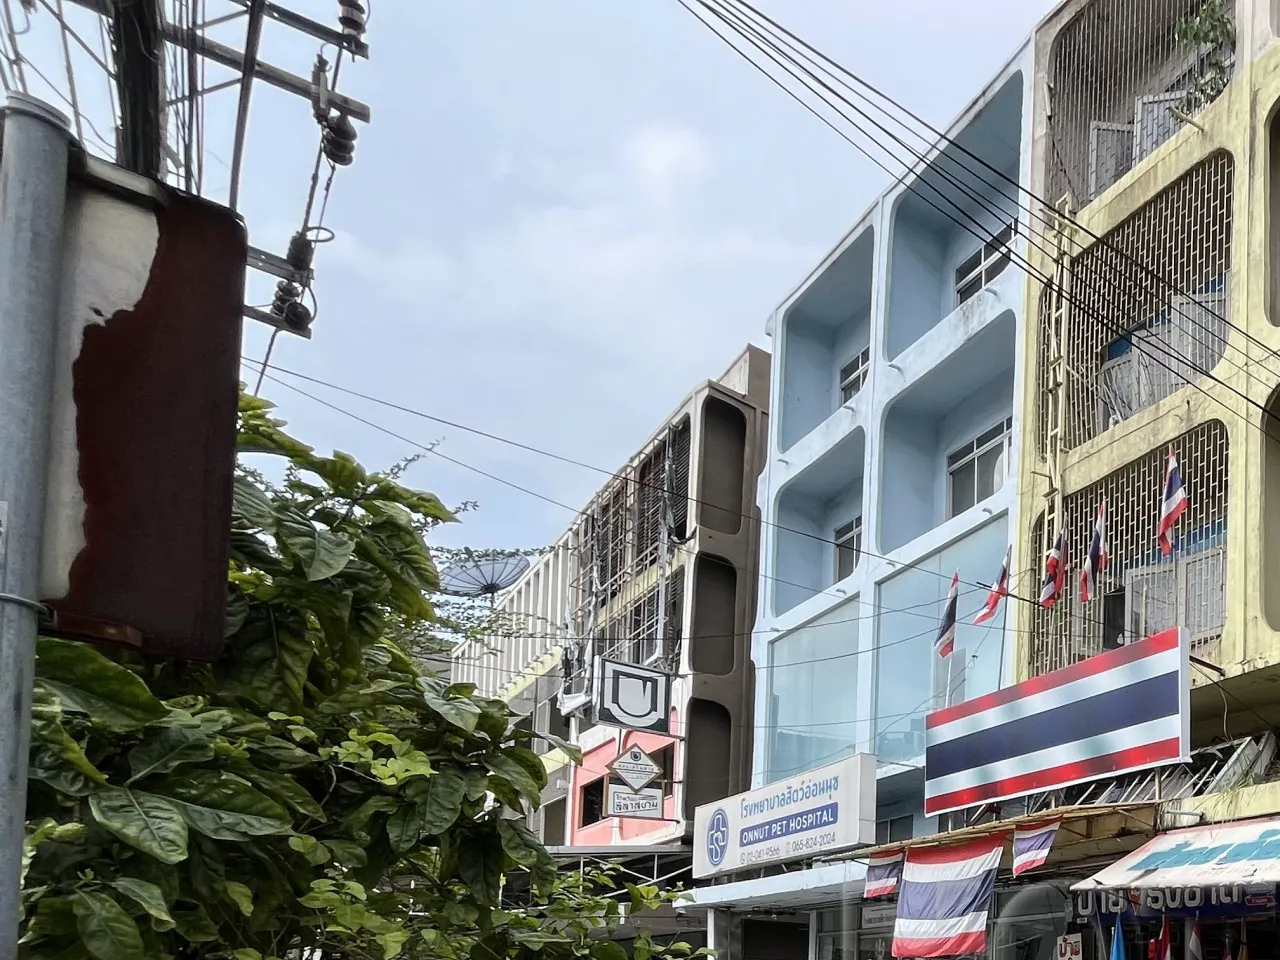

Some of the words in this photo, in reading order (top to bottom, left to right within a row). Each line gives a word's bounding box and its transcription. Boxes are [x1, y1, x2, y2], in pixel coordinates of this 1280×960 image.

[741, 775, 839, 819] โรงพยาบาลสัตว์อ่อนนุช
[742, 827, 770, 845] ONNUT
[771, 819, 788, 837] PET
[789, 809, 834, 833] HOSPITAL
[746, 847, 780, 863] 02-041-9566
[791, 832, 836, 852] 065-824-2024
